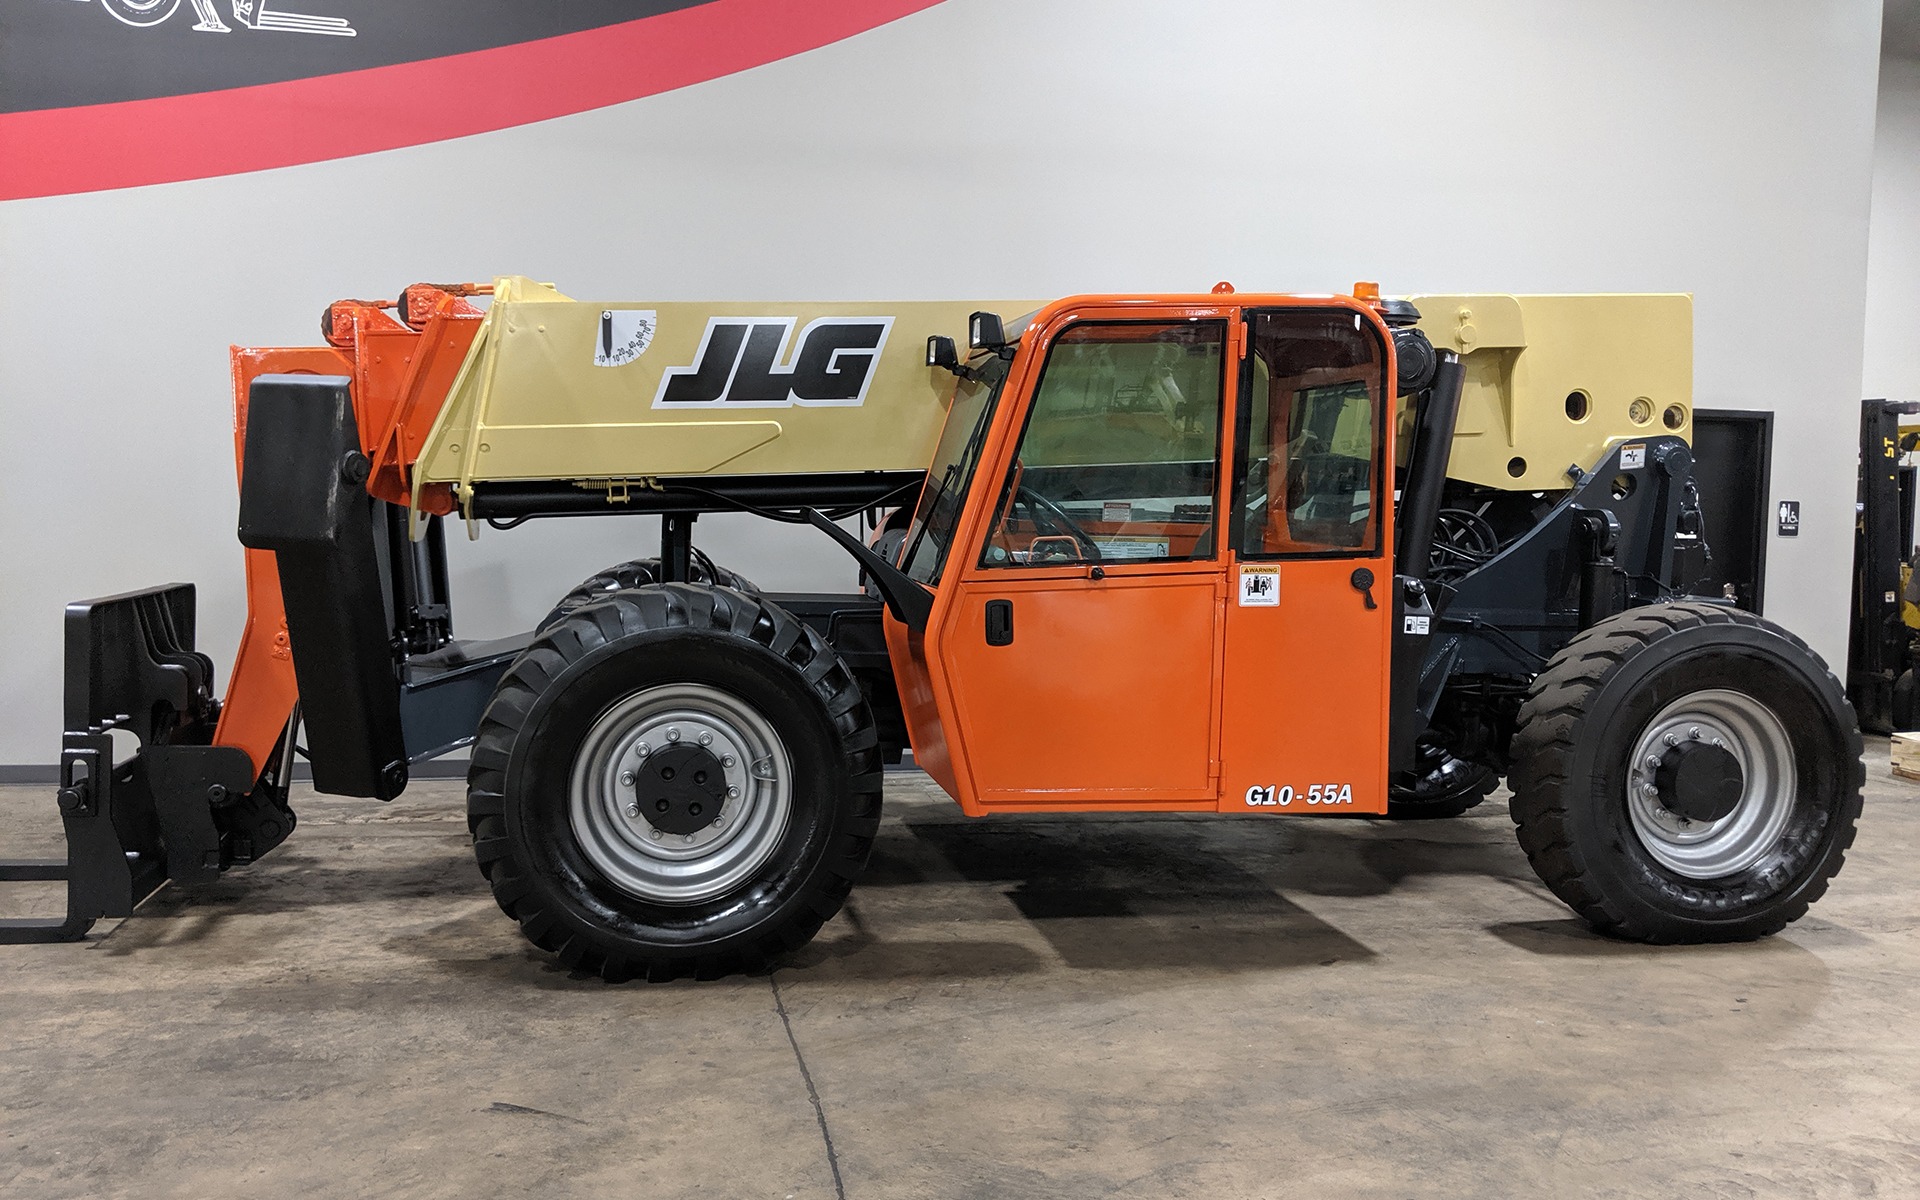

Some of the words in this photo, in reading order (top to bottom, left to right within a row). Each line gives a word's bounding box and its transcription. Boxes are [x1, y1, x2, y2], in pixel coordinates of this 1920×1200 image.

[639, 319, 648, 327] 80
[635, 331, 644, 339] 60
[643, 326, 651, 335] 70
[628, 340, 636, 349] 40
[636, 340, 645, 348] 50
[617, 347, 626, 356] 20
[626, 348, 634, 358] 30
[612, 354, 620, 362] 10
[660, 322, 887, 403] JLG
[1245, 784, 1353, 806] G10-55A
